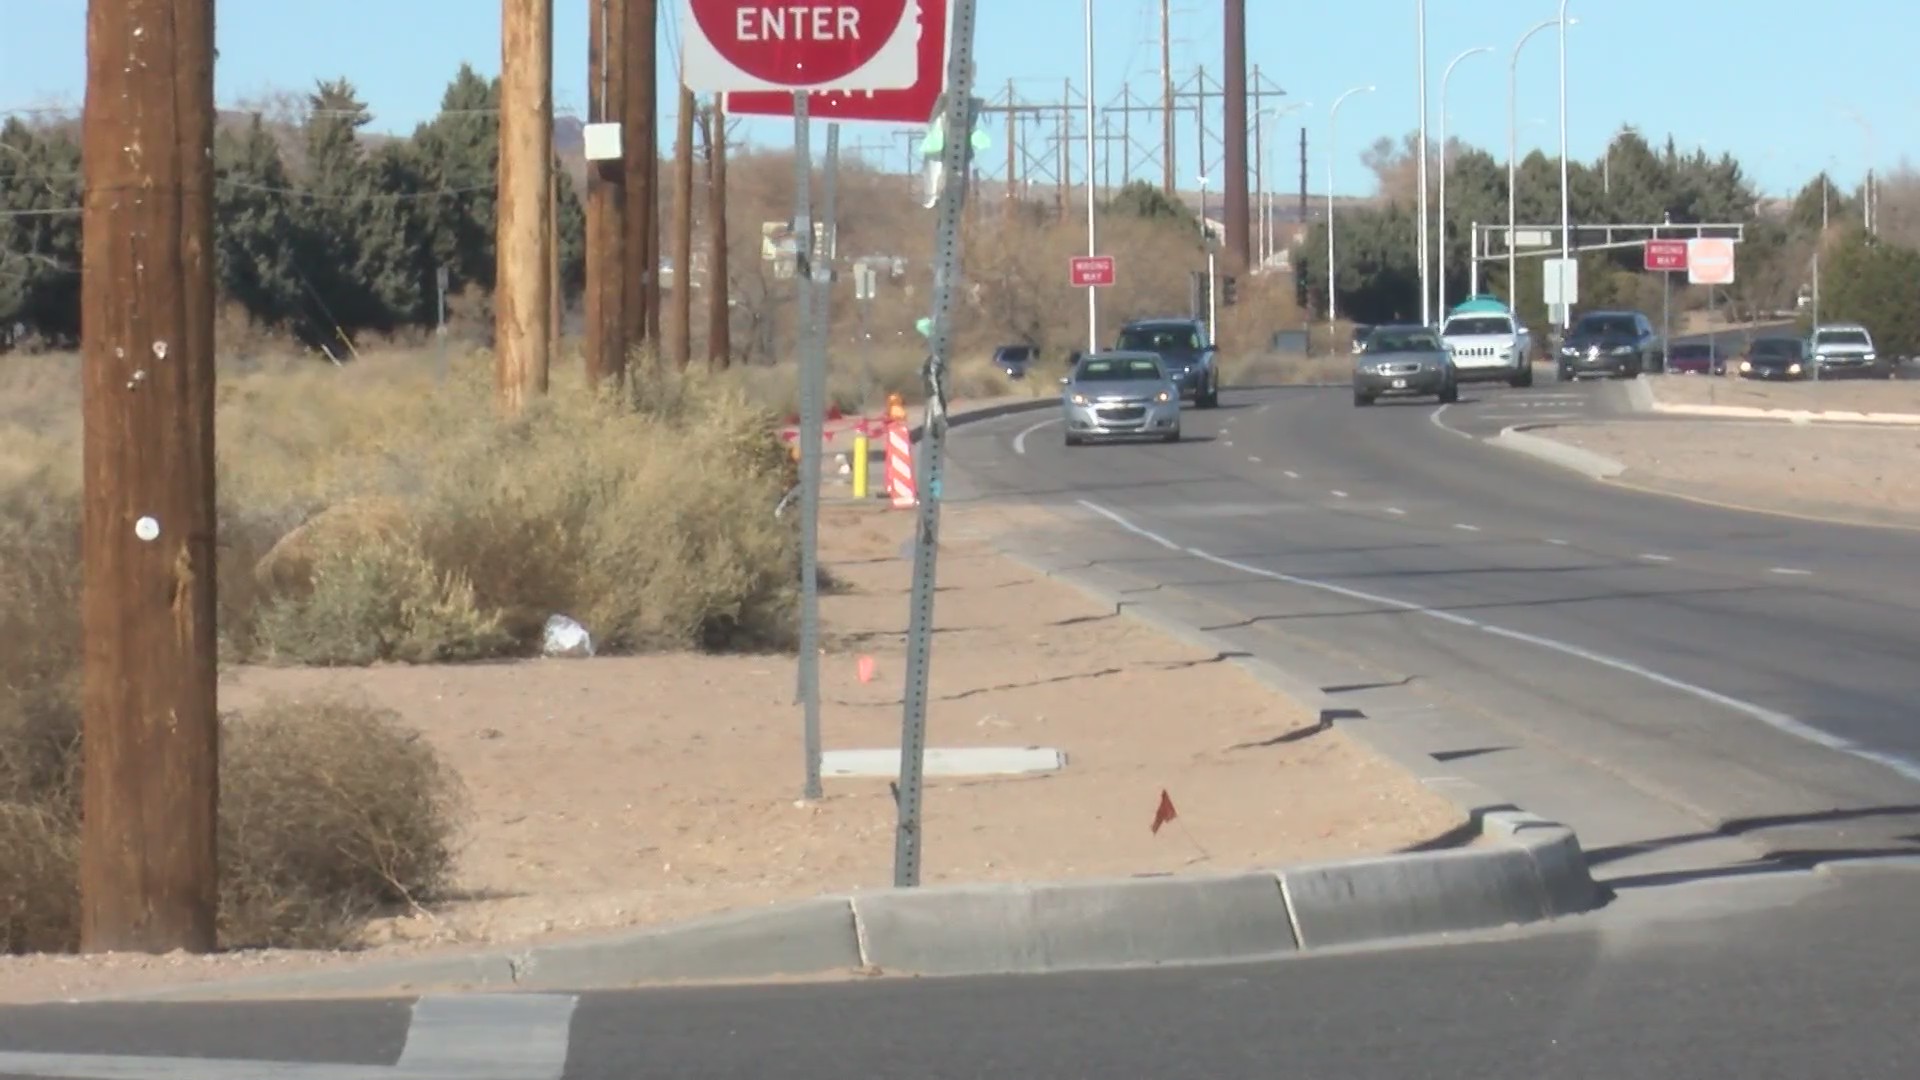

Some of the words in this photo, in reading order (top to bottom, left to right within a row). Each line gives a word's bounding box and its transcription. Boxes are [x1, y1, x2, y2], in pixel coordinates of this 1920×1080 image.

[736, 6, 860, 41] ENTER
[1656, 256, 1678, 265] WAY
[1082, 272, 1103, 281] WAY
